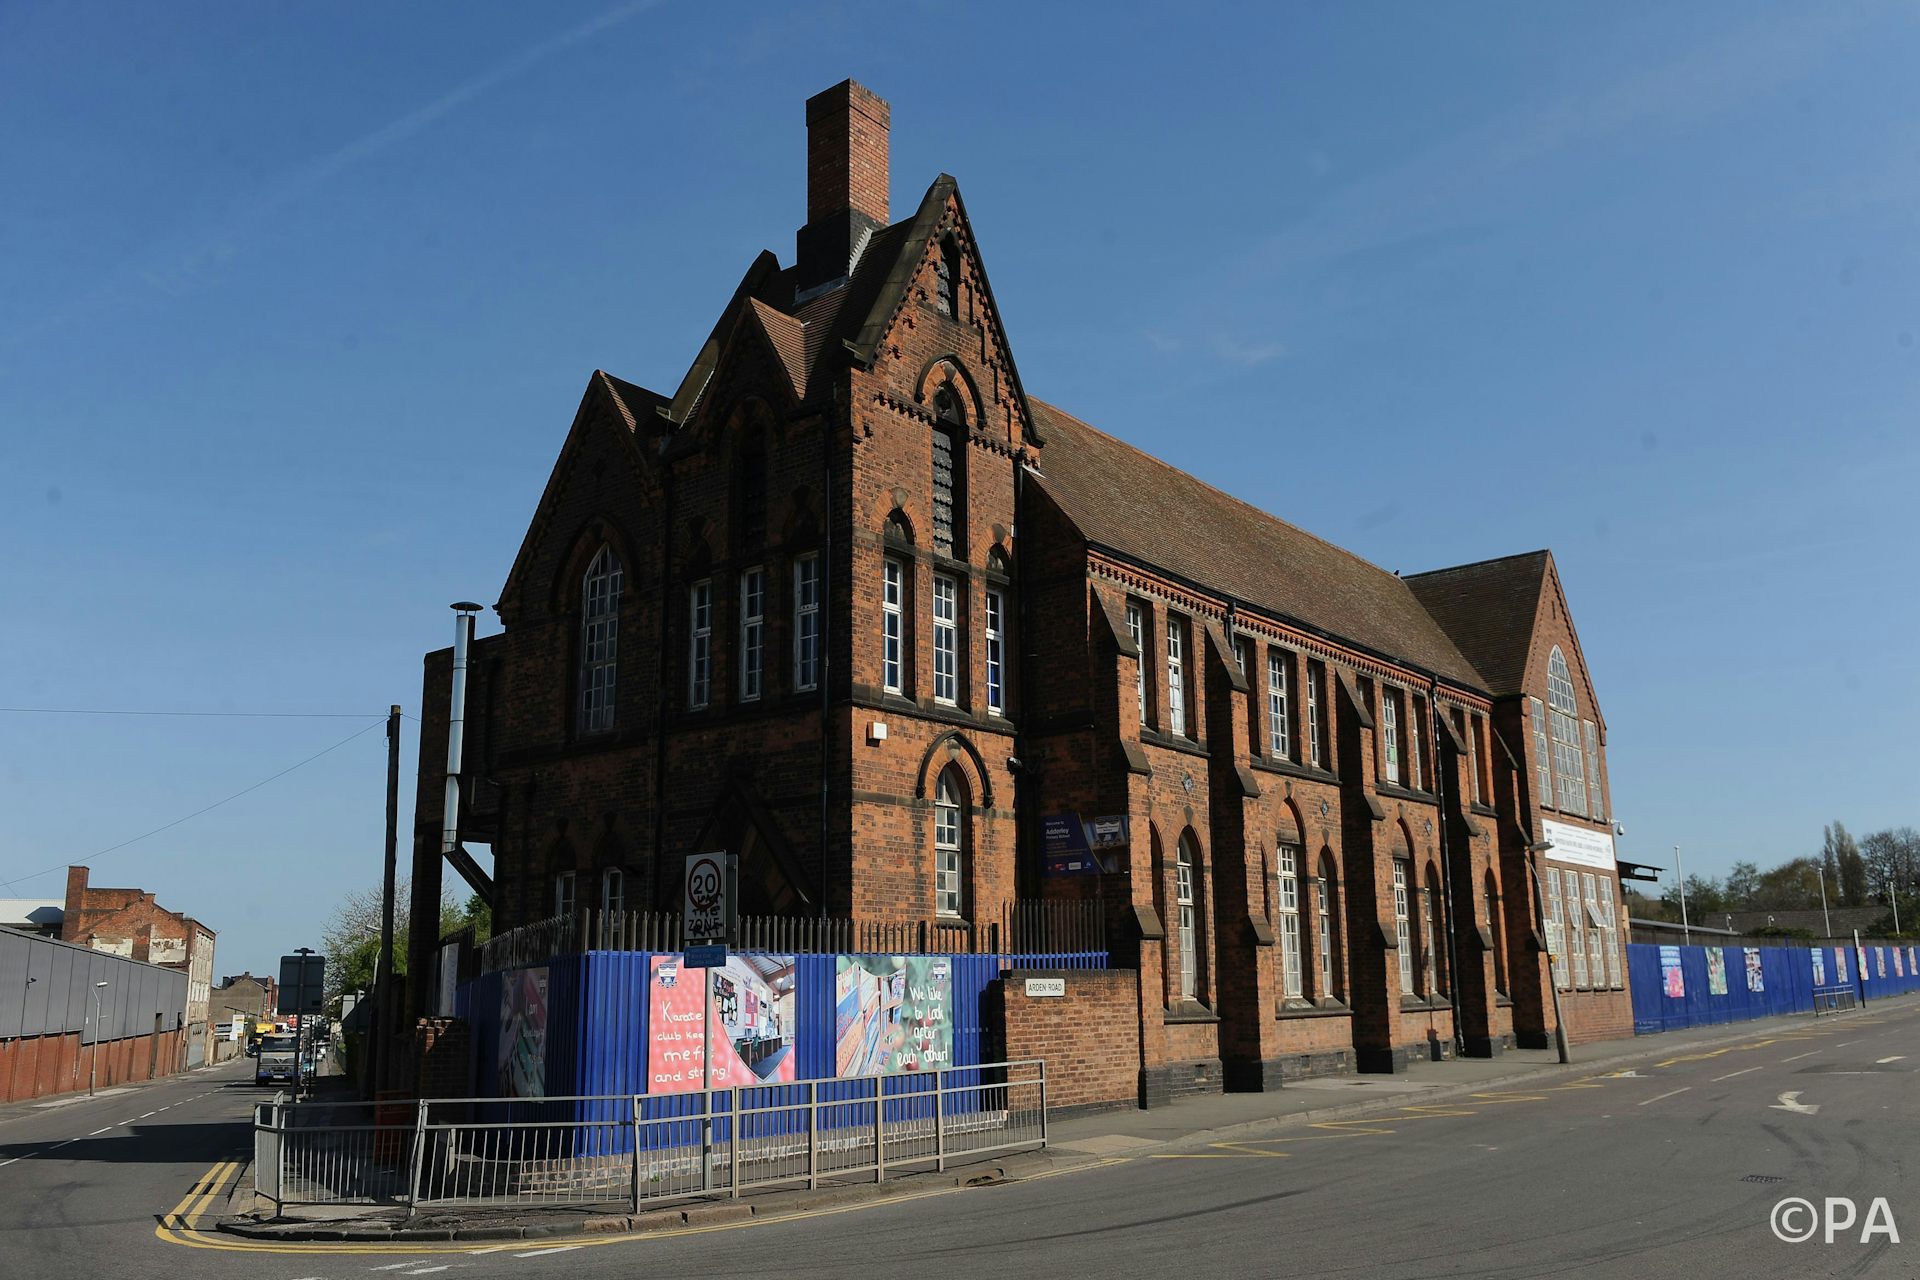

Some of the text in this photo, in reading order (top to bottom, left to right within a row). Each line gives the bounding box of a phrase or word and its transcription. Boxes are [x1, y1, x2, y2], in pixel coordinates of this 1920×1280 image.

[1046, 827, 1069, 836] Adderley
[693, 873, 716, 895] 20
[688, 918, 720, 931] ZONE
[909, 986, 943, 1001] We like
[1029, 983, 1062, 992] ARDEN ROAD
[662, 1000, 704, 1024] Karate
[914, 1004, 944, 1020] to look
[657, 1031, 682, 1041] club
[913, 1021, 937, 1050] after
[897, 1042, 948, 1067] each other!
[655, 1059, 731, 1083] and strng!
